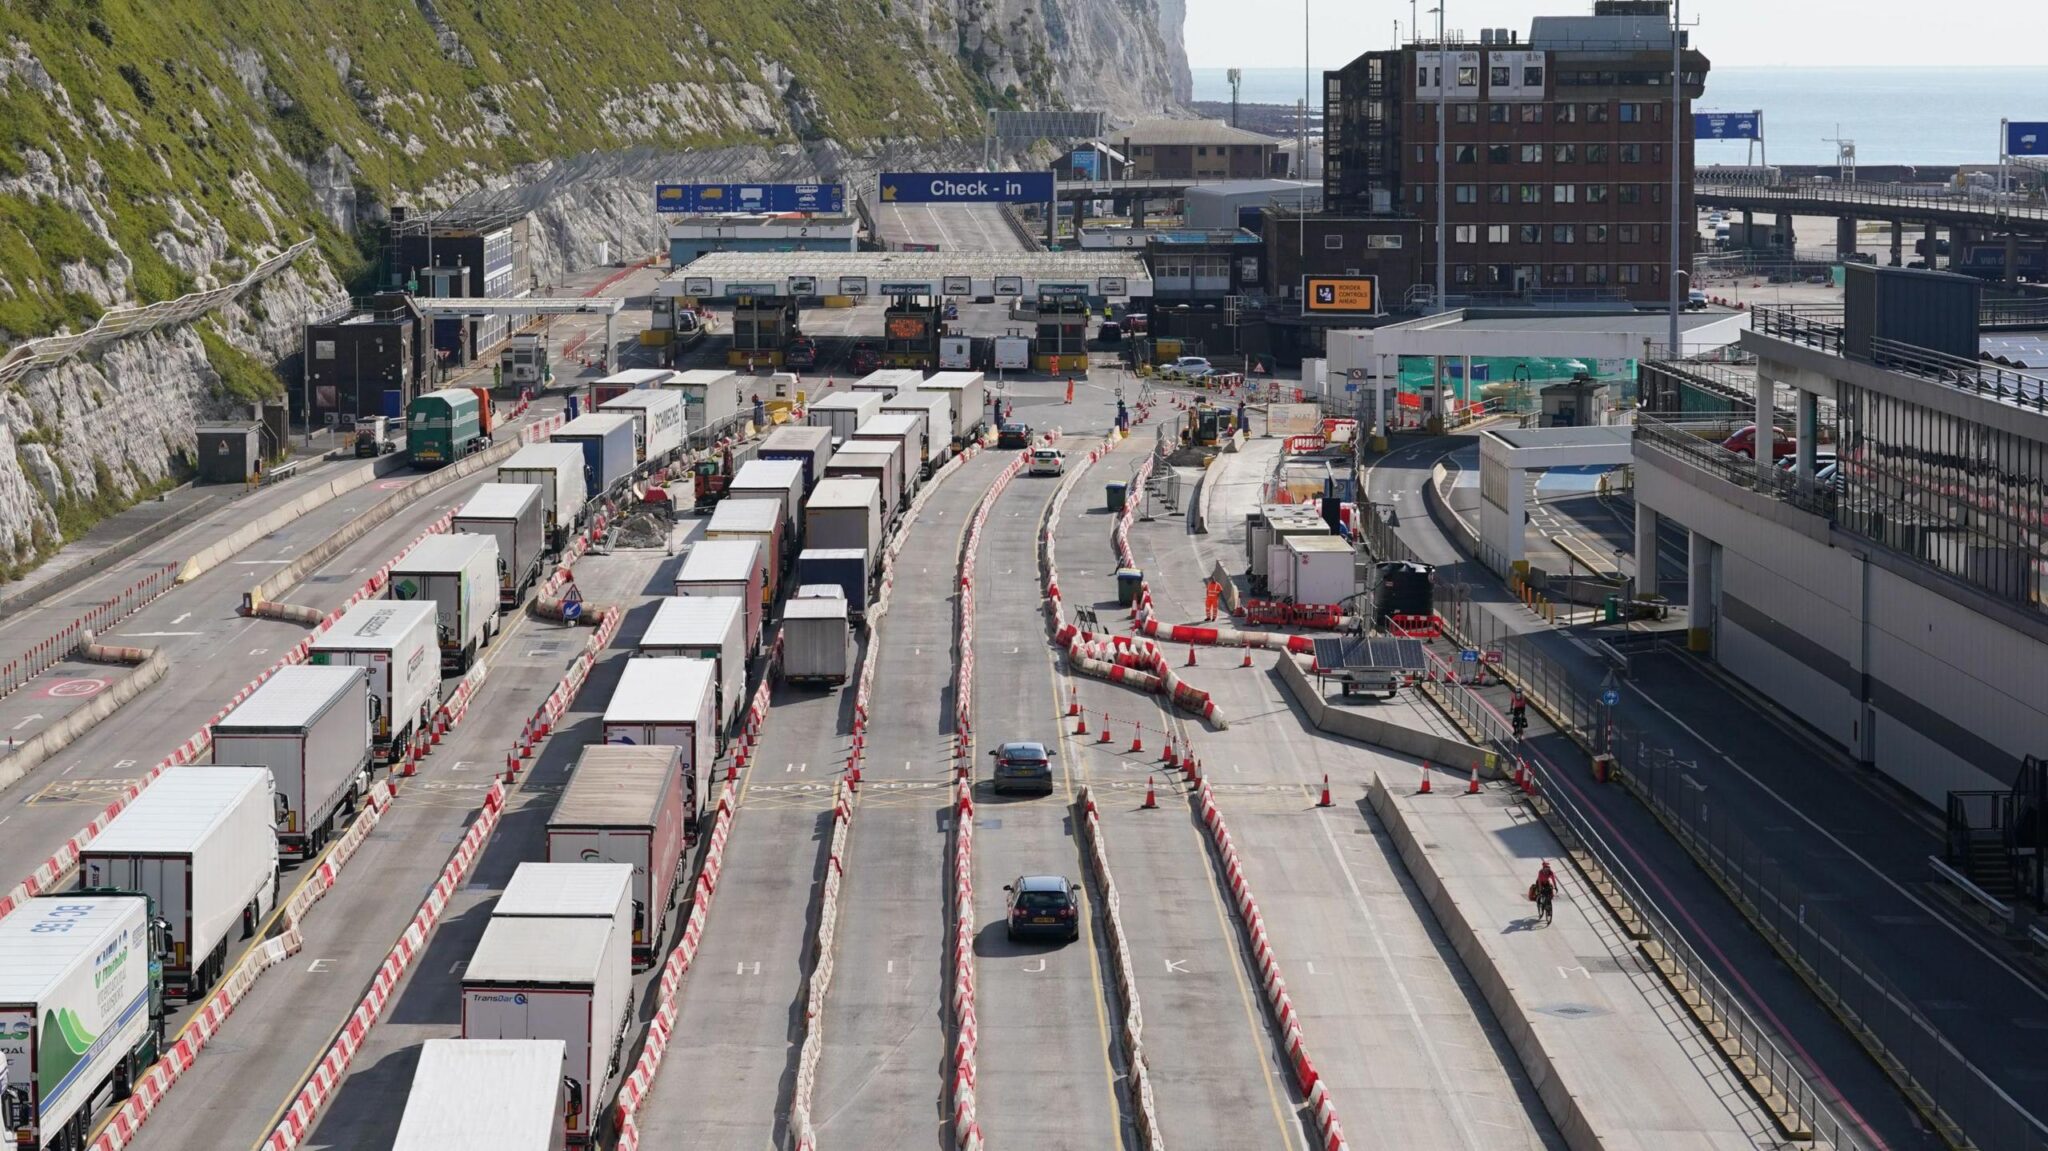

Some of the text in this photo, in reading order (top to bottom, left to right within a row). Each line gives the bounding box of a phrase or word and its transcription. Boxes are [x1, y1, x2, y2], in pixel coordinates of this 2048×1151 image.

[930, 180, 988, 196] Check
[1005, 180, 1022, 196] in
[717, 228, 721, 236] 1
[800, 228, 807, 237] 2
[1126, 236, 1133, 246] 3
[114, 760, 137, 768] B
[452, 761, 475, 770] E
[786, 763, 806, 772] H
[307, 958, 337, 973] E
[736, 961, 761, 975] H
[1023, 958, 1046, 973] J
[1165, 959, 1191, 973] K
[1307, 961, 1334, 975] L
[1556, 966, 1592, 979] M
